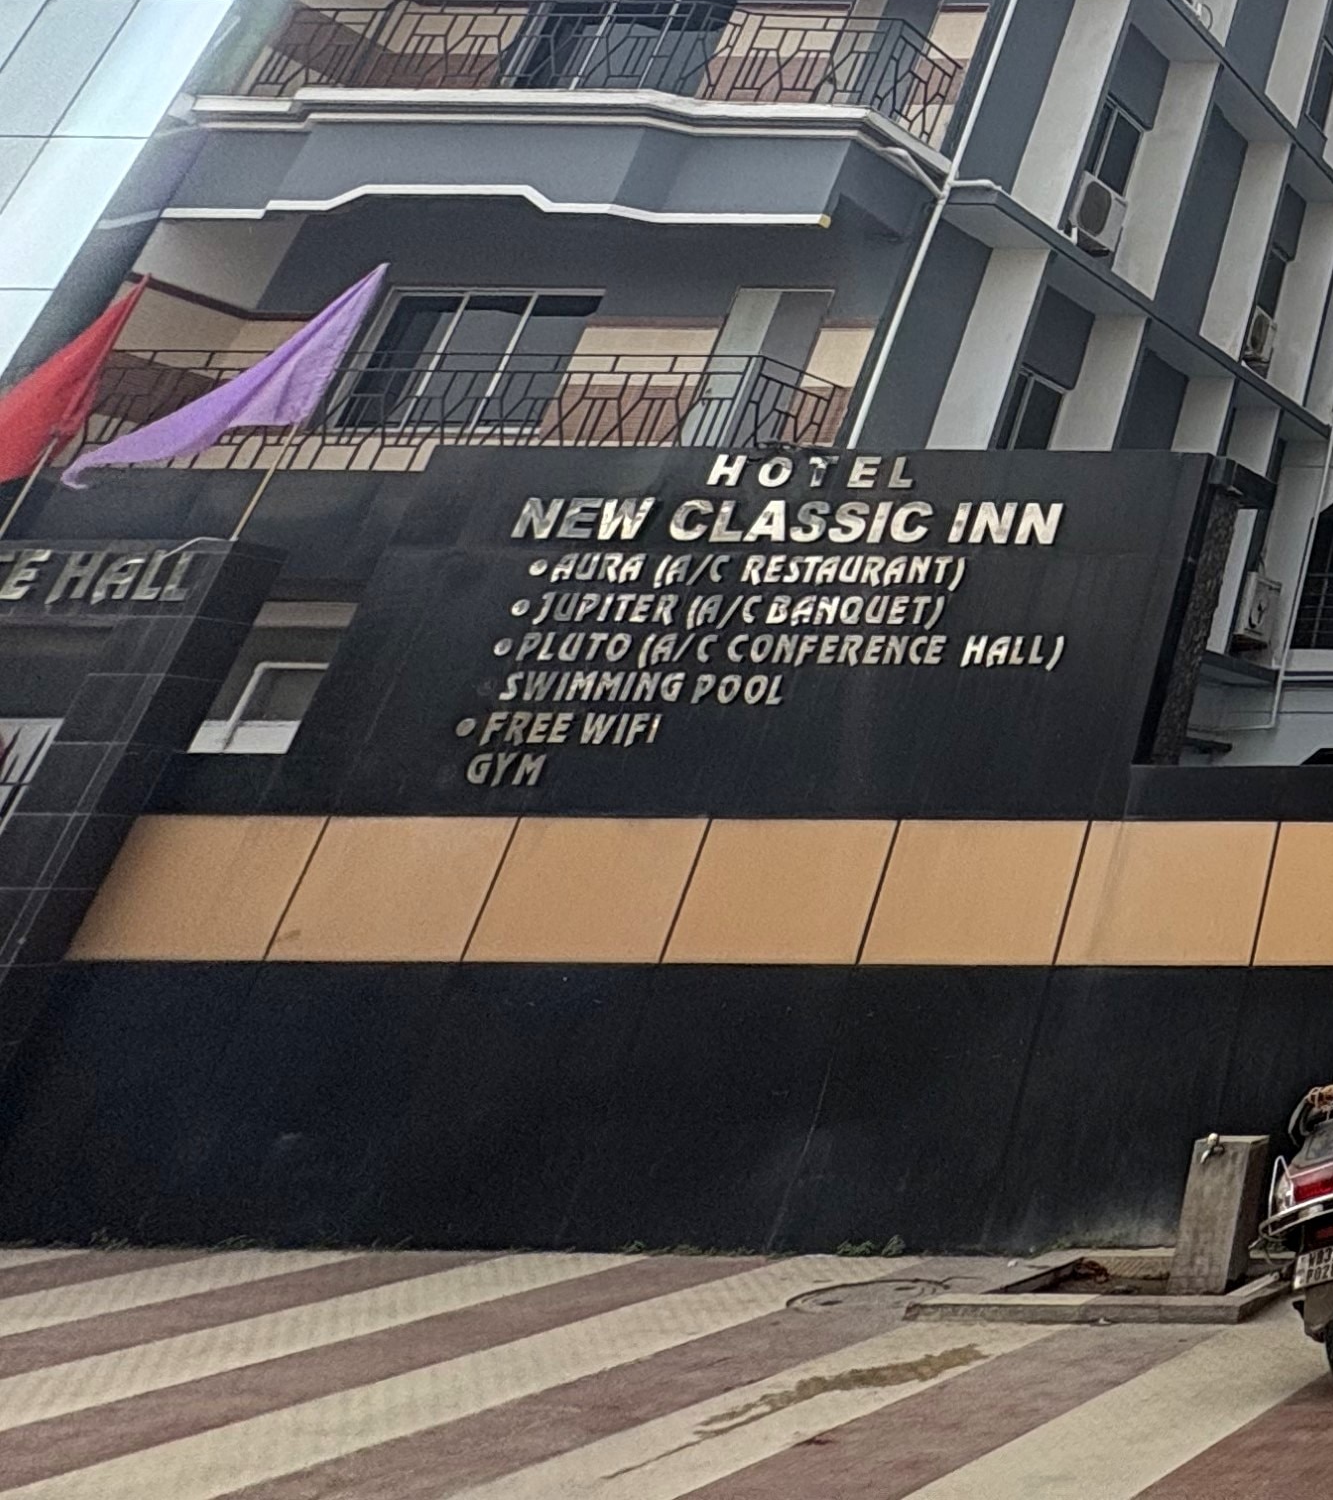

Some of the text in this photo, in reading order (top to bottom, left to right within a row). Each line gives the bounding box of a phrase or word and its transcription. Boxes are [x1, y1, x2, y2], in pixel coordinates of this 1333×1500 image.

[705, 453, 914, 489] HOTEL
[510, 496, 1064, 545] NEW CLASSIC INN
[549, 552, 967, 591] AURA (A/C RESTAURANT)
[531, 591, 946, 631] JUPITER (A/C BANQUET)
[514, 631, 1065, 671] PLUTO (A/C CONFERENCE HALL)
[498, 670, 783, 706] SWIMMING POOL
[479, 710, 663, 748] FREE WIFI
[466, 752, 547, 788] GYM
